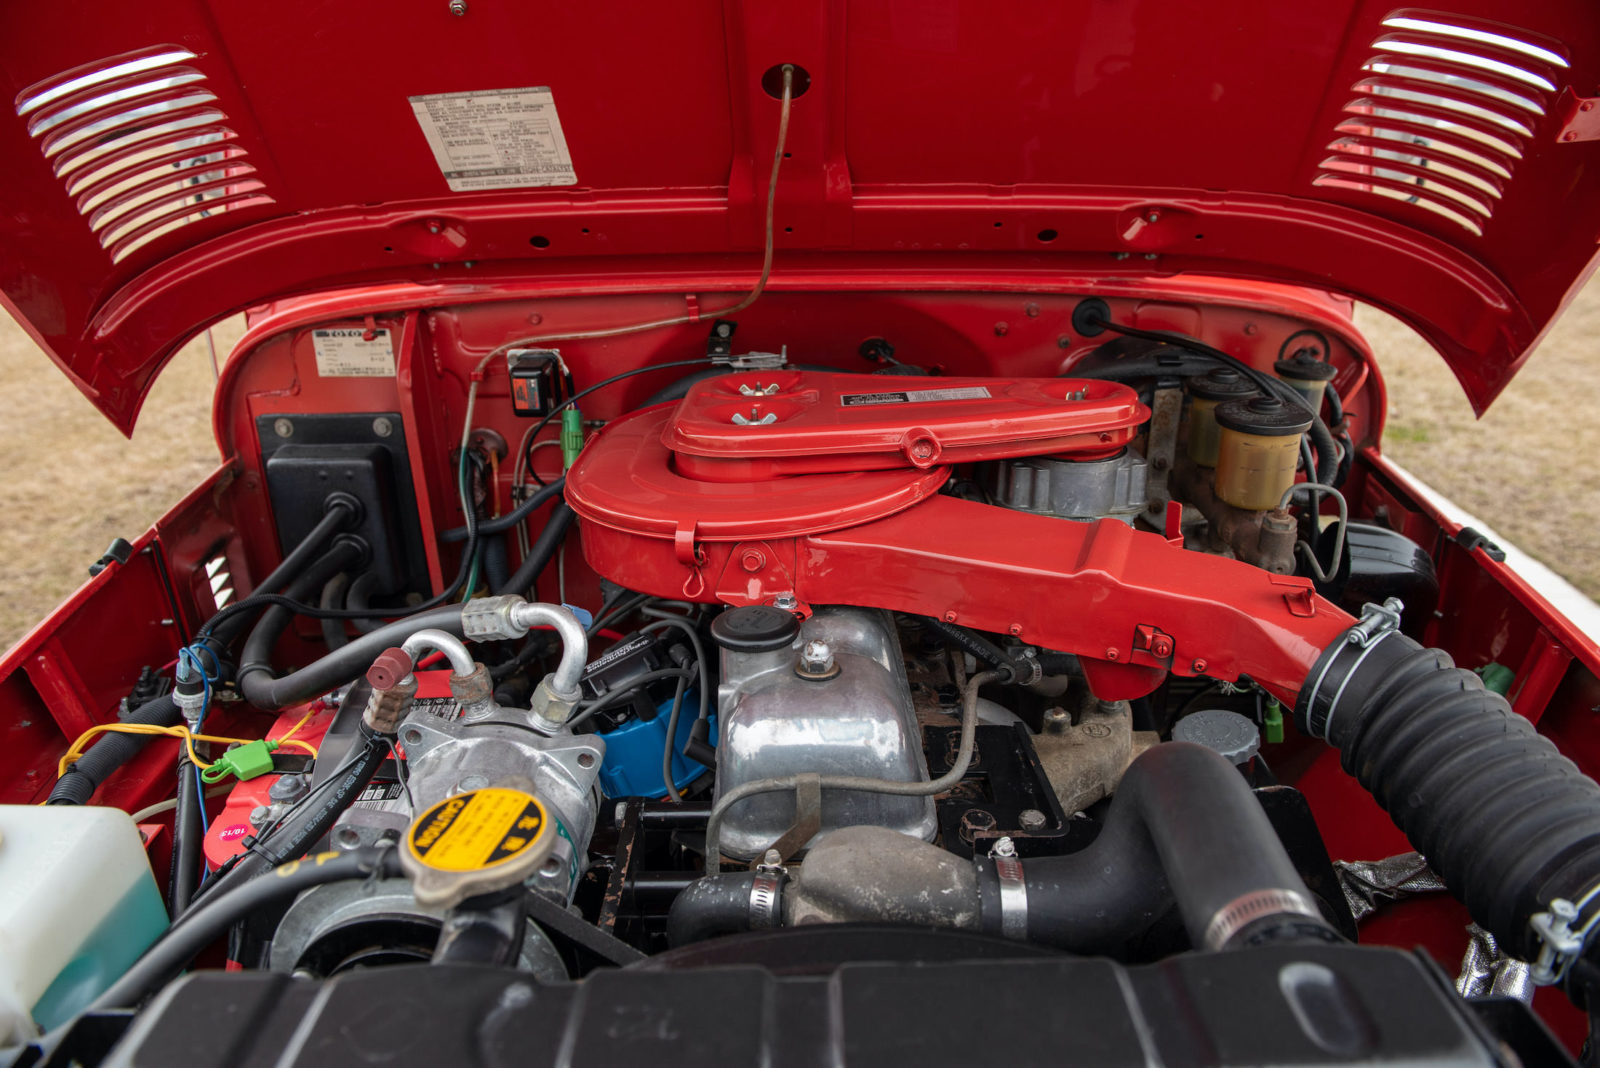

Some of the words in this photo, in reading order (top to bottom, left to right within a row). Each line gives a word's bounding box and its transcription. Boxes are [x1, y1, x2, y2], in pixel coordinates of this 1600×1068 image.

[969, 641, 990, 659] MADE
[221, 828, 245, 837] 10/13
[414, 799, 466, 848] CAUTION
